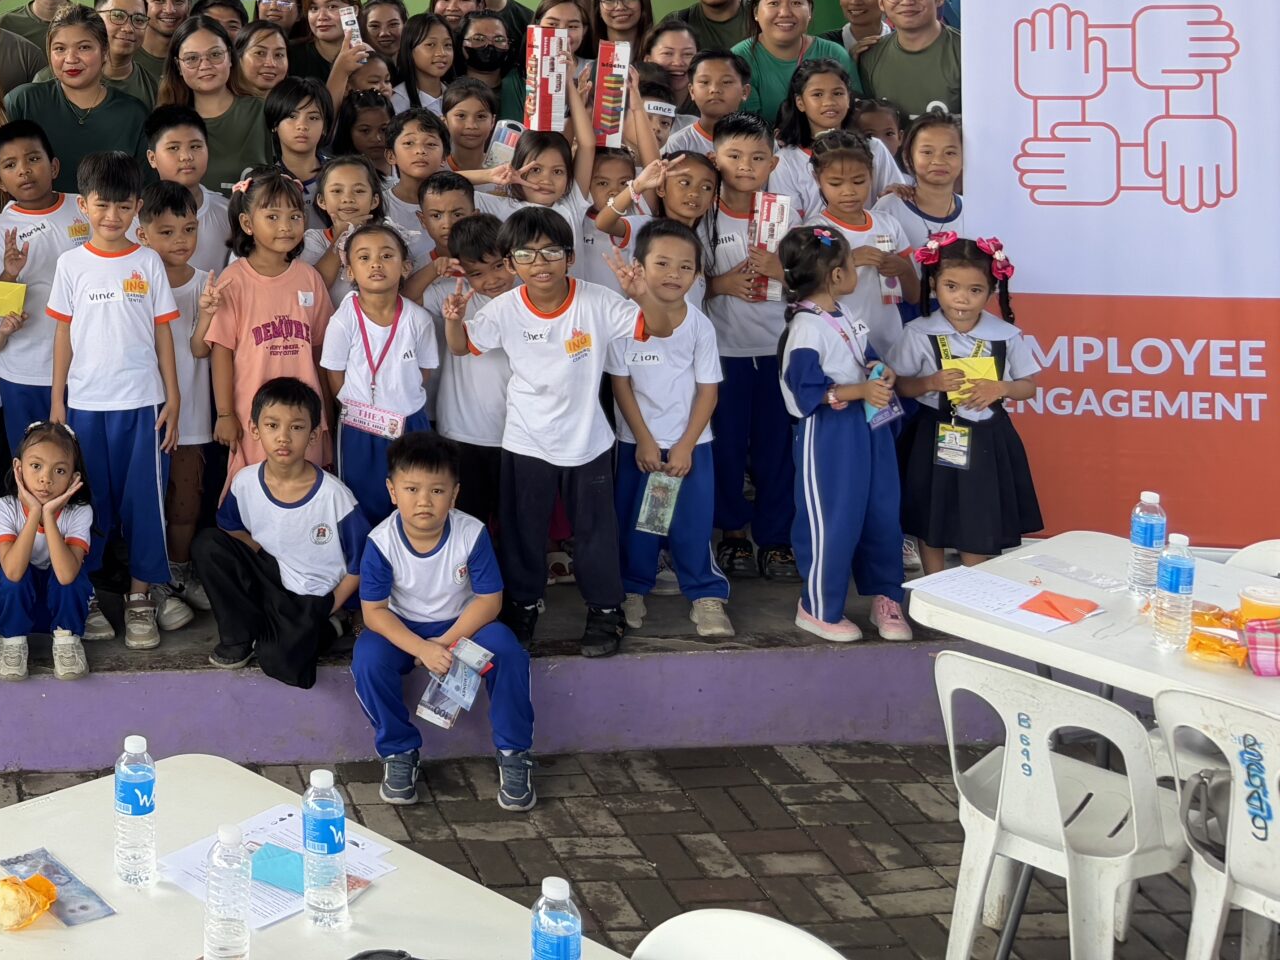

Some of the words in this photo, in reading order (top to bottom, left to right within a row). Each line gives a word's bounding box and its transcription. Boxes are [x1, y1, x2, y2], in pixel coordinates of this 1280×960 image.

[71, 225, 88, 236] ING
[126, 280, 145, 291] ING
[252, 319, 311, 346] DEMURE
[568, 336, 587, 351] ING
[631, 352, 660, 362] Zion
[1023, 335, 1266, 377] MPLOYEE
[358, 410, 385, 423] THEA
